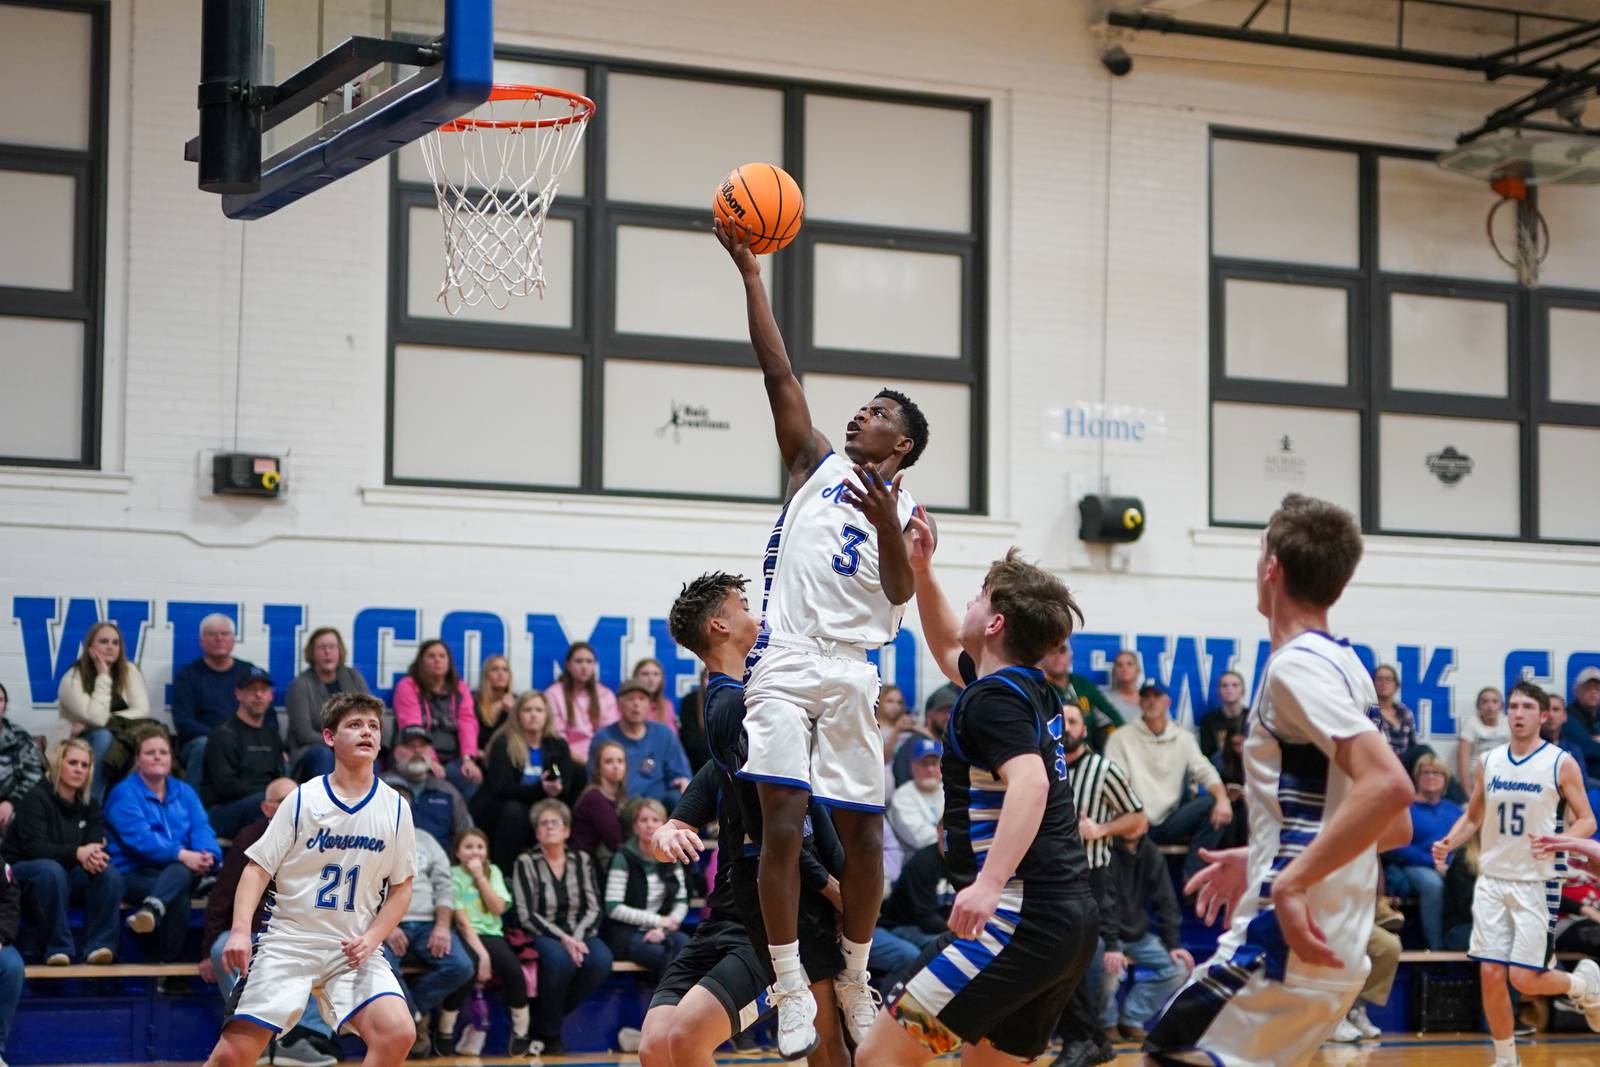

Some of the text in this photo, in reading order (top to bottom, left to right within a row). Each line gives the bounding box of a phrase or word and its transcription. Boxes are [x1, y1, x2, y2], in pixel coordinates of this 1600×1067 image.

[718, 177, 747, 221] ilson
[1064, 407, 1146, 442] Home
[832, 523, 869, 577] 3
[1487, 776, 1543, 795] Norsemen
[1497, 802, 1526, 836] 15
[306, 827, 386, 853] Norsemen
[315, 864, 361, 912] 21
